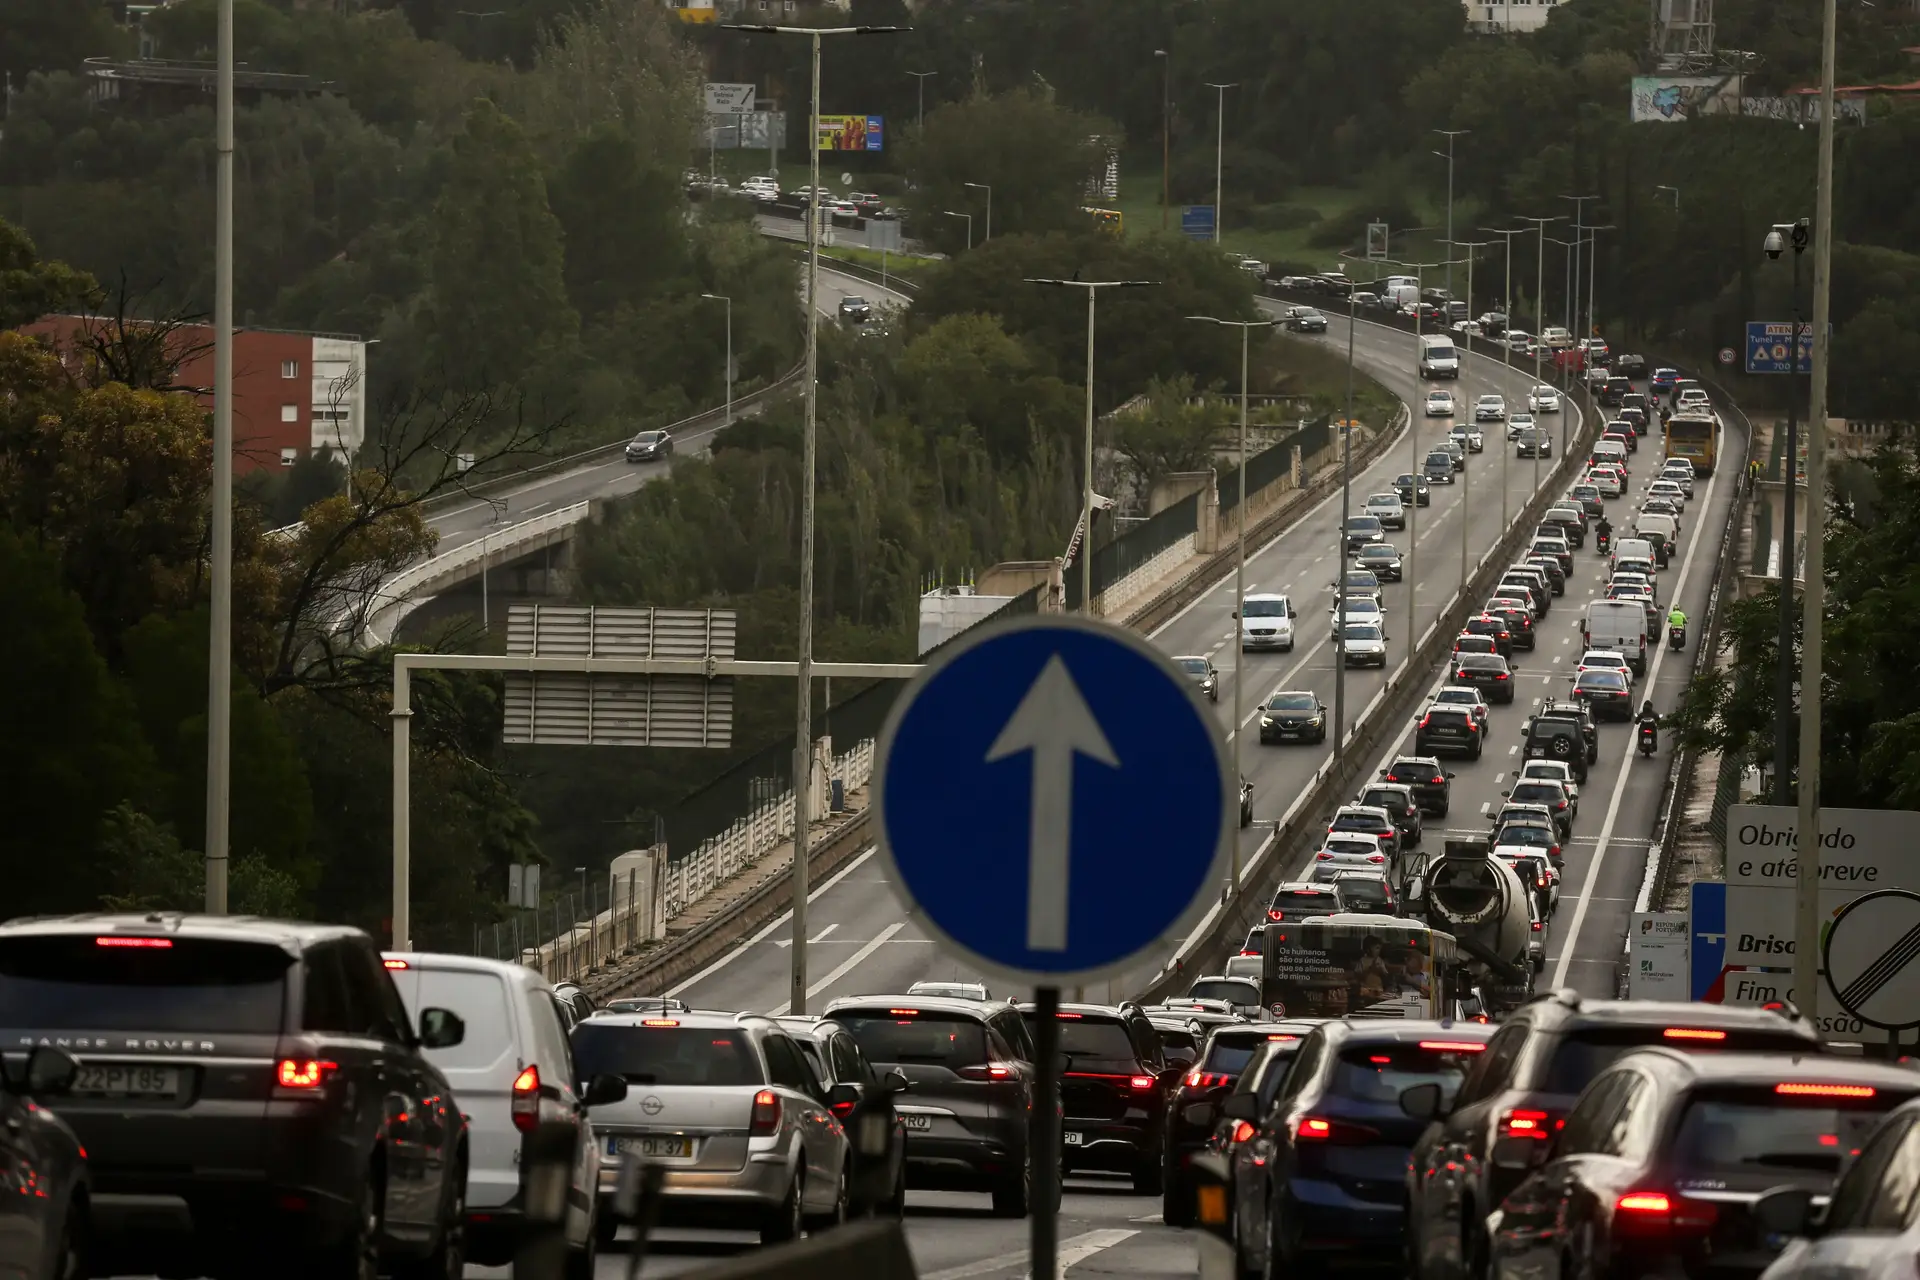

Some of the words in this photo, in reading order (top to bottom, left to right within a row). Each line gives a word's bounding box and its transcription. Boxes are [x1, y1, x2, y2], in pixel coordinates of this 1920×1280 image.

[1768, 325, 1811, 334] ATENO
[1750, 334, 1773, 344] Tunel
[1773, 362, 1791, 370] 700
[1738, 861, 1753, 877] e
[1760, 858, 1797, 878] até
[1817, 864, 1878, 882] reve
[1279, 947, 1290, 955] Os
[1291, 947, 1326, 956] humanos
[1279, 955, 1293, 963] são
[1304, 956, 1330, 965] únicos
[1278, 965, 1294, 973] que
[1304, 965, 1345, 973] alimentam
[1289, 973, 1311, 981] mimo
[1736, 979, 1777, 1001] Fim
[19, 1036, 108, 1048] RANGE
[125, 1038, 215, 1052] ROVER
